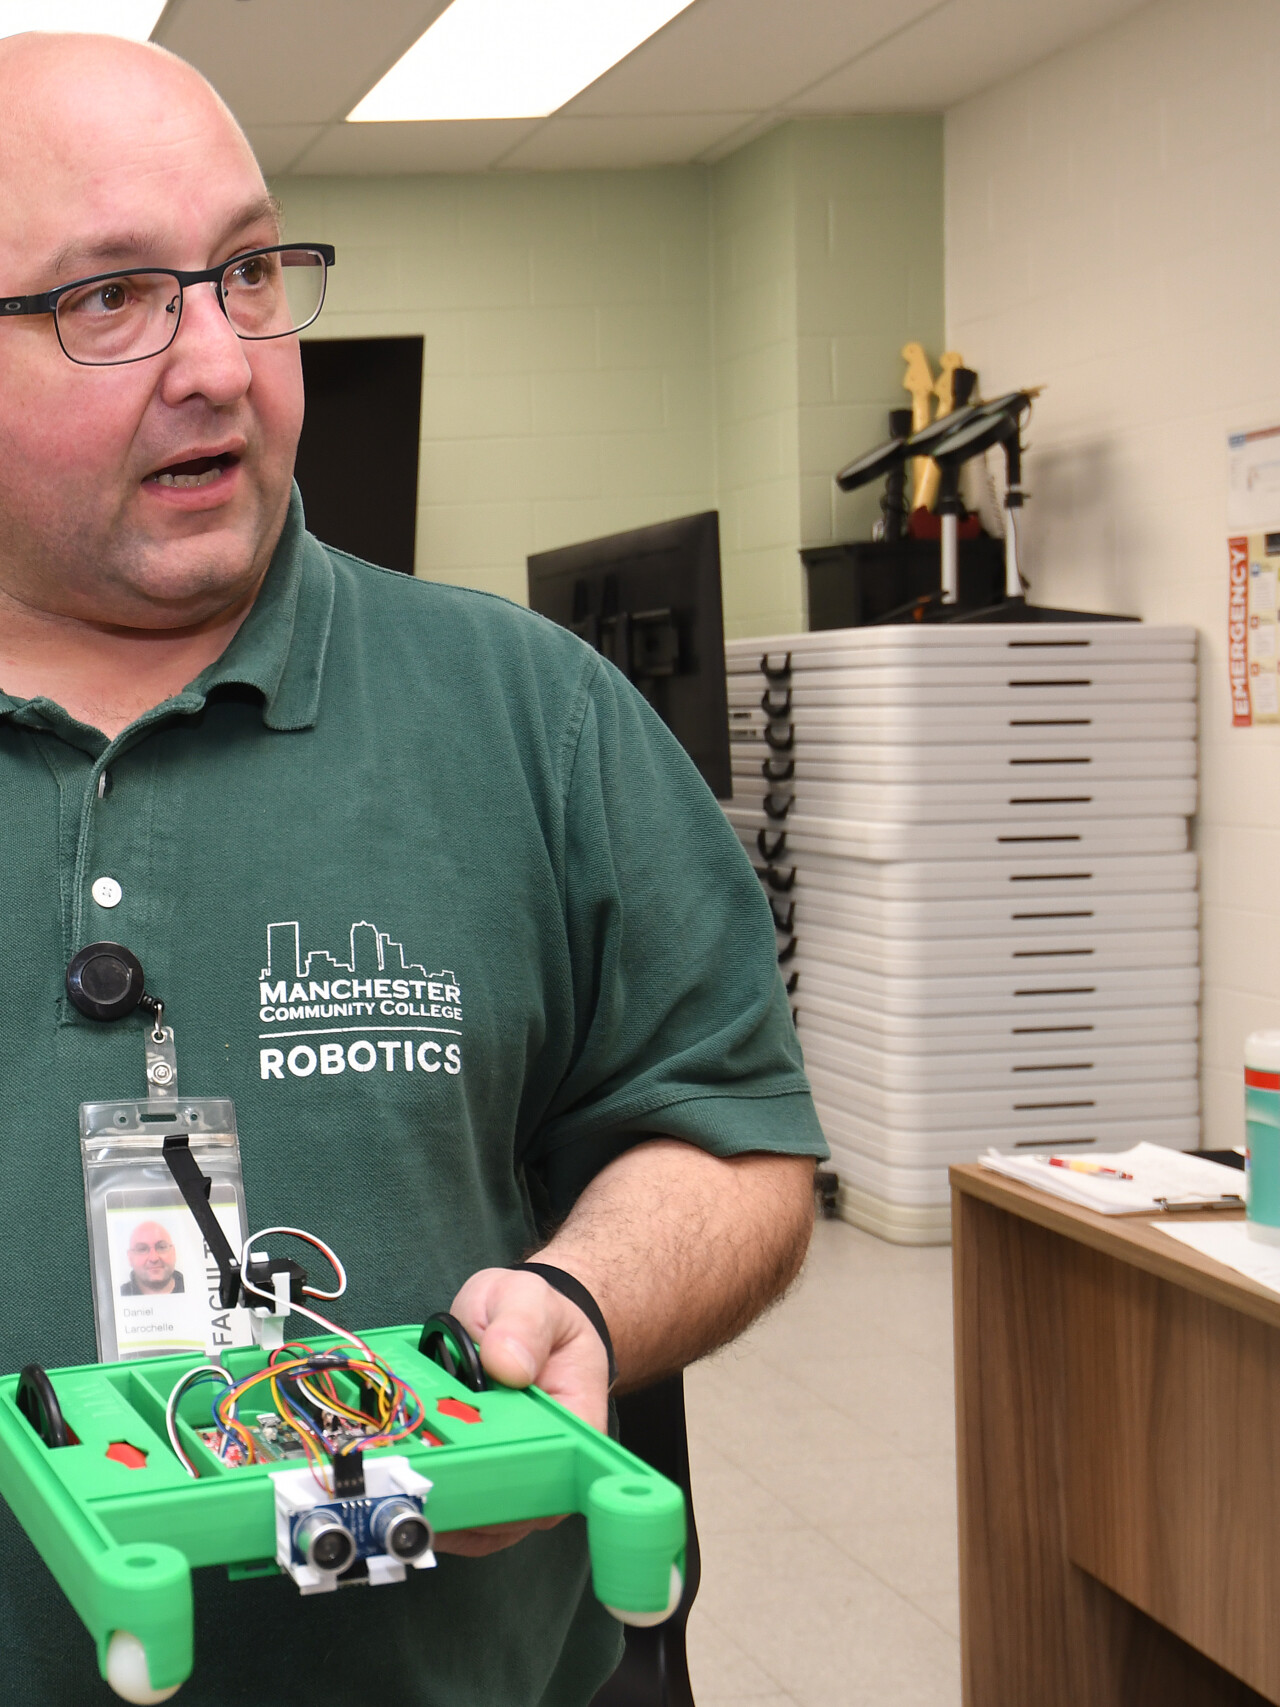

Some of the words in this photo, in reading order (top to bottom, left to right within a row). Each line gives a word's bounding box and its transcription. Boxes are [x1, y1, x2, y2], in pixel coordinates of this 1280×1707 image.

[1230, 549, 1250, 716] EMERGENCY
[260, 979, 462, 1005] MANCHESTER
[259, 1002, 376, 1022] COMMUNITY
[380, 1000, 463, 1021] COLLEGE
[260, 1040, 462, 1080] ROBOTICS
[123, 1307, 154, 1318] Daniel
[124, 1322, 174, 1335] Larochelle
